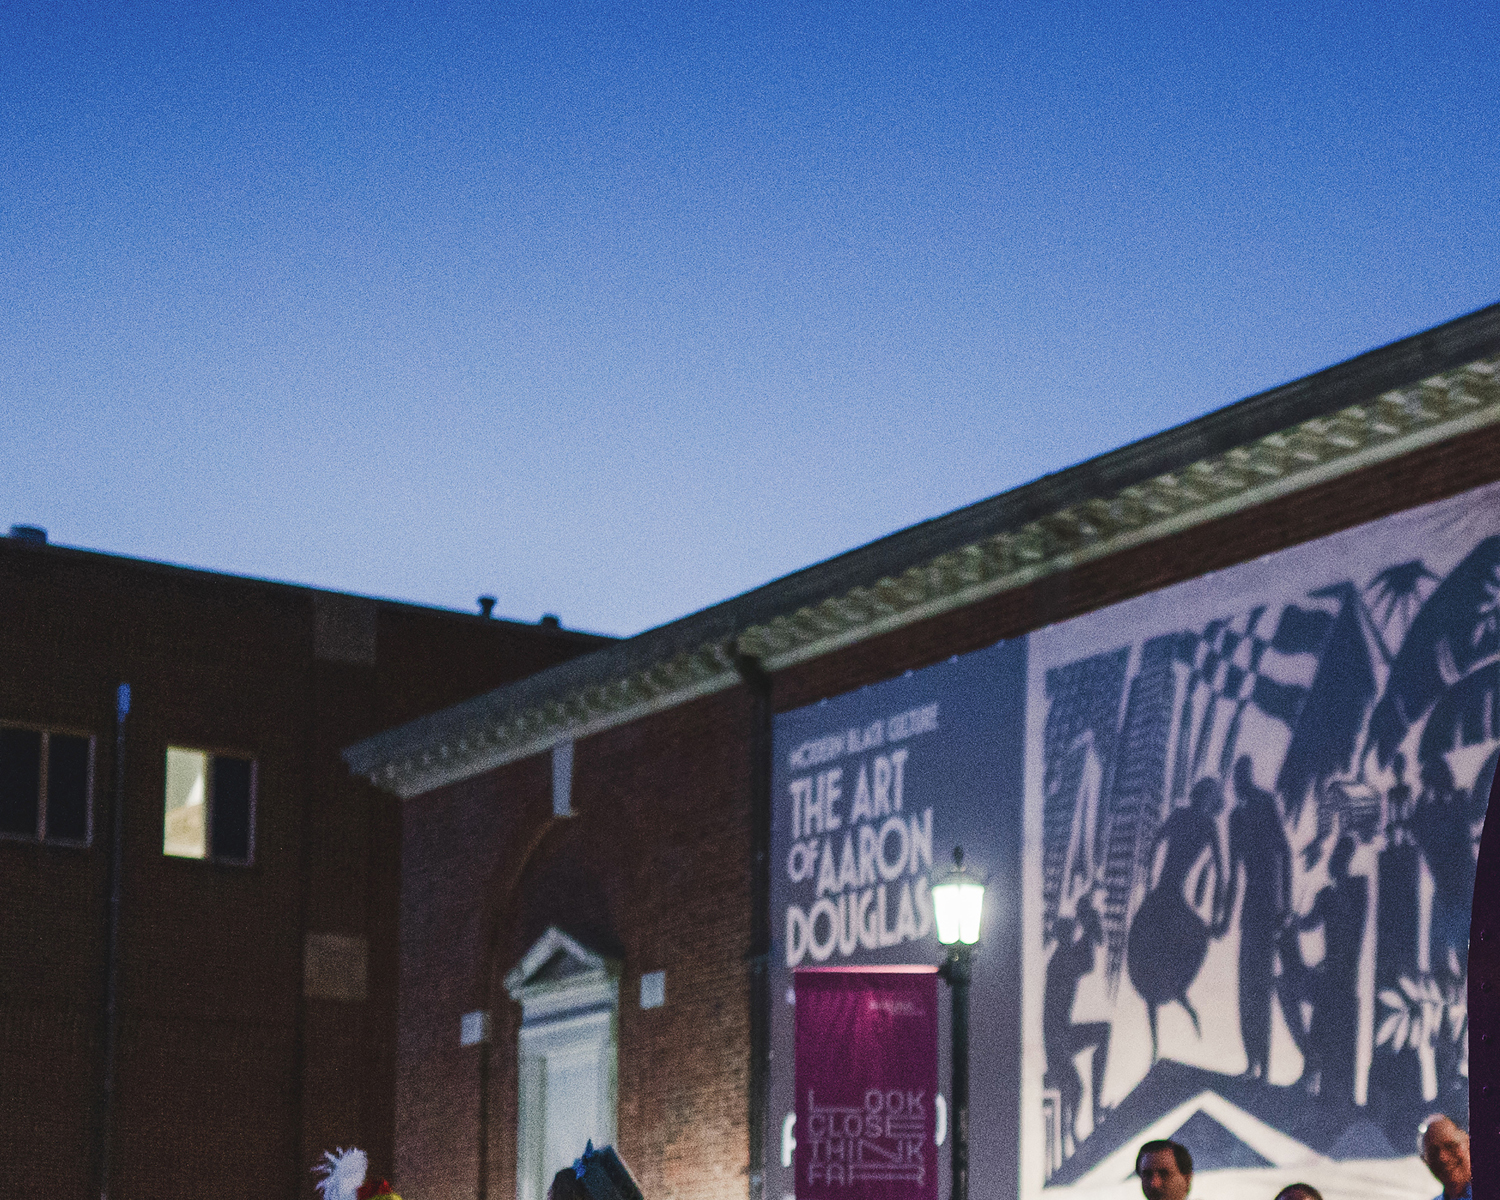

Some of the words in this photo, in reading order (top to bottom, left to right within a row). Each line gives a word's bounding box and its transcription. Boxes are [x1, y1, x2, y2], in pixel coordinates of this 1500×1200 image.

[790, 769, 843, 838] THE
[850, 749, 908, 825] ART
[788, 840, 818, 882] OF
[817, 806, 933, 898] AARON
[786, 877, 931, 967] DOUGLAS
[808, 1089, 926, 1114] LOOK
[808, 1113, 926, 1138] CLOSE
[808, 1138, 925, 1164] THINK
[808, 1163, 926, 1187] FAR
